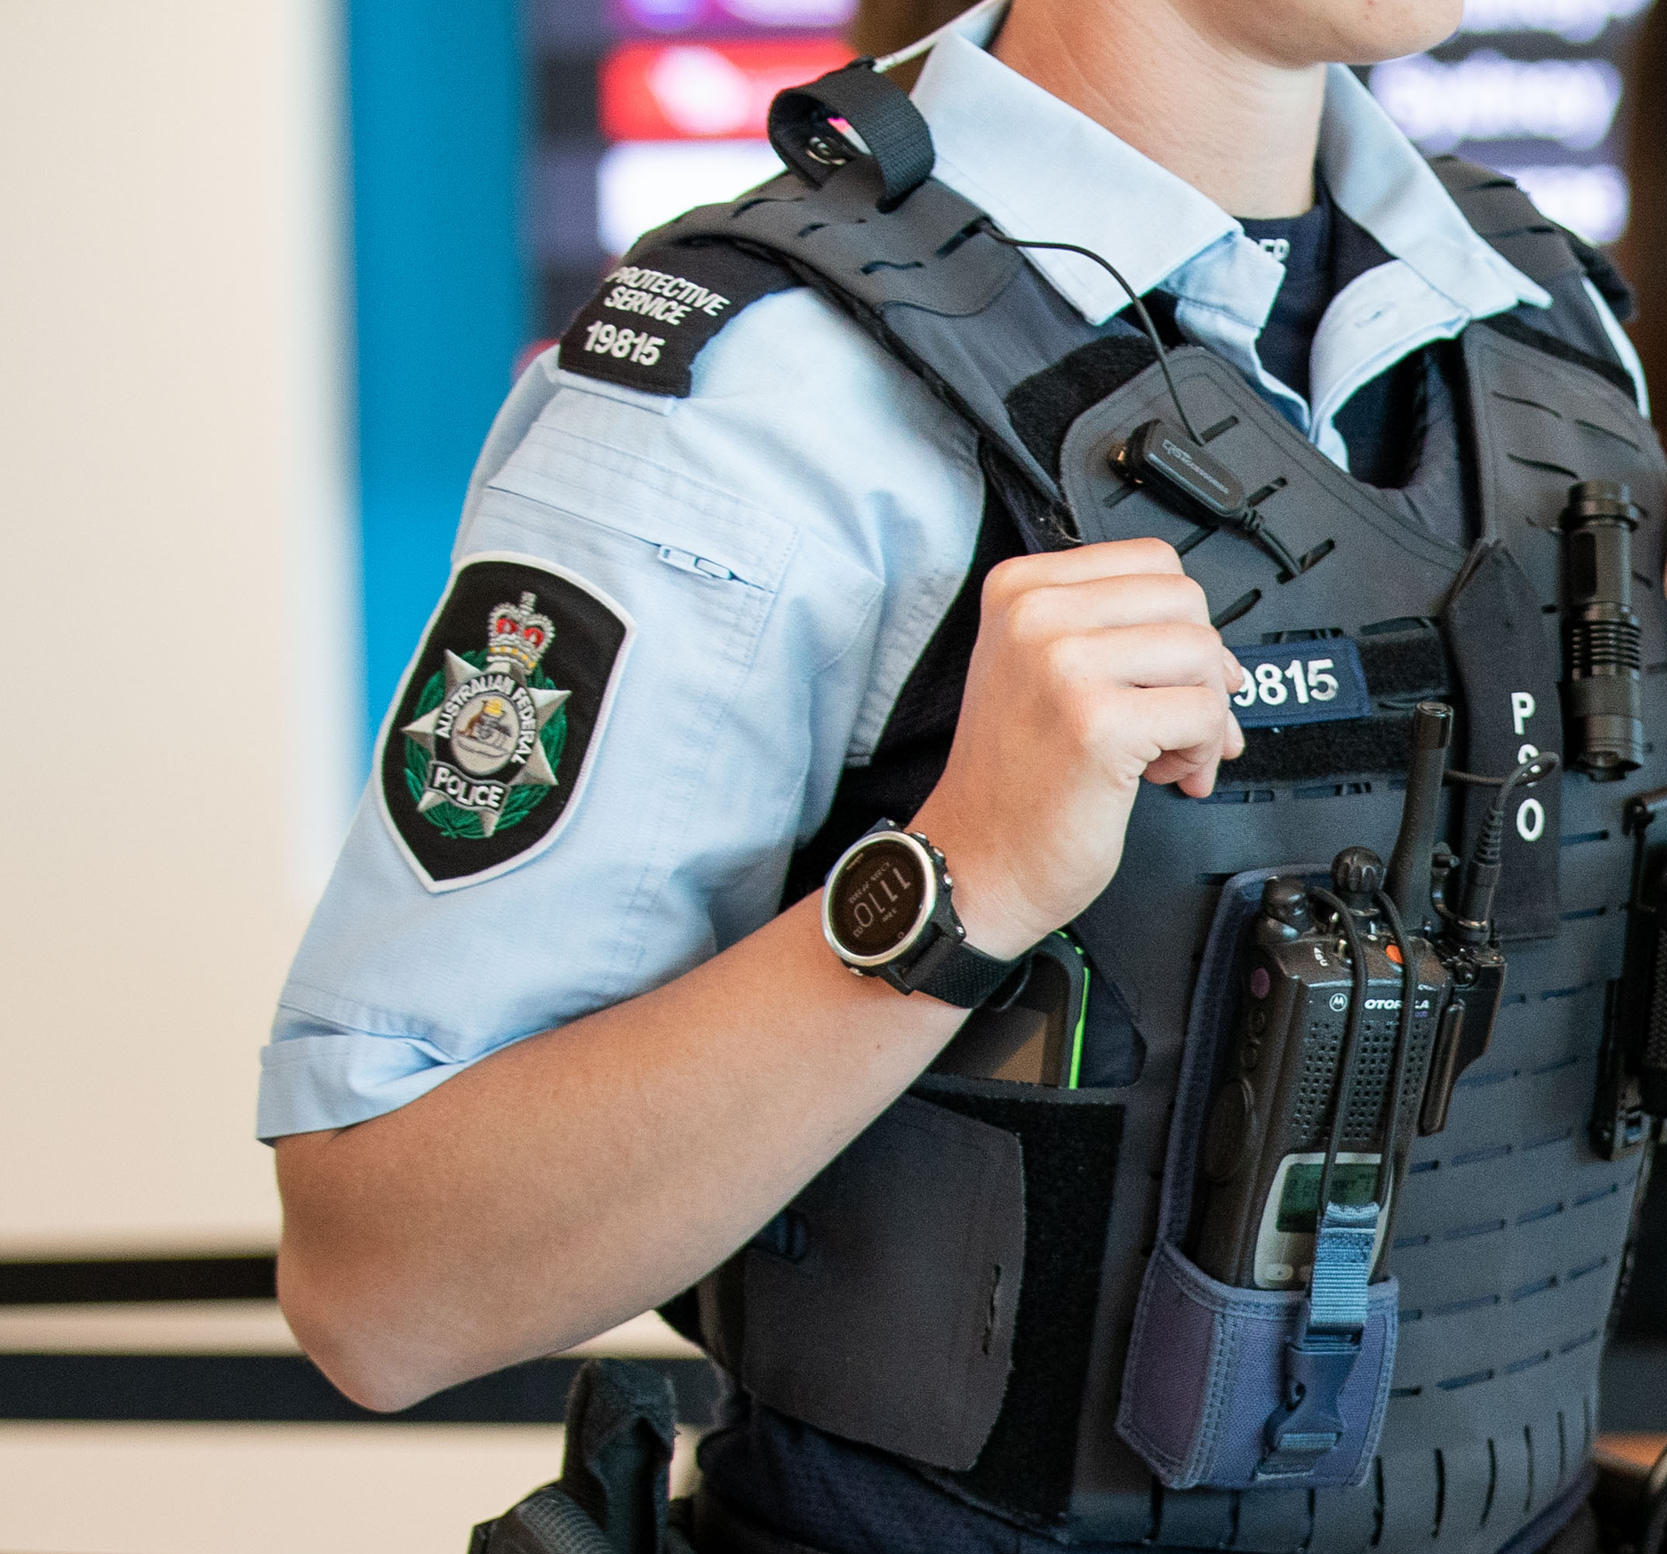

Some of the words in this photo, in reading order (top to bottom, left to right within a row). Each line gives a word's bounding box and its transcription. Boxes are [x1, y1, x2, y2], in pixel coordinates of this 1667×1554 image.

[603, 286, 693, 326] SERVICE
[604, 266, 731, 317] PROTECTIVE
[584, 320, 667, 366] 19815
[1233, 658, 1340, 707] 9815
[435, 674, 517, 739] AUSTRALIAN
[510, 687, 537, 765] FEDERAL
[433, 766, 504, 808] POLICE
